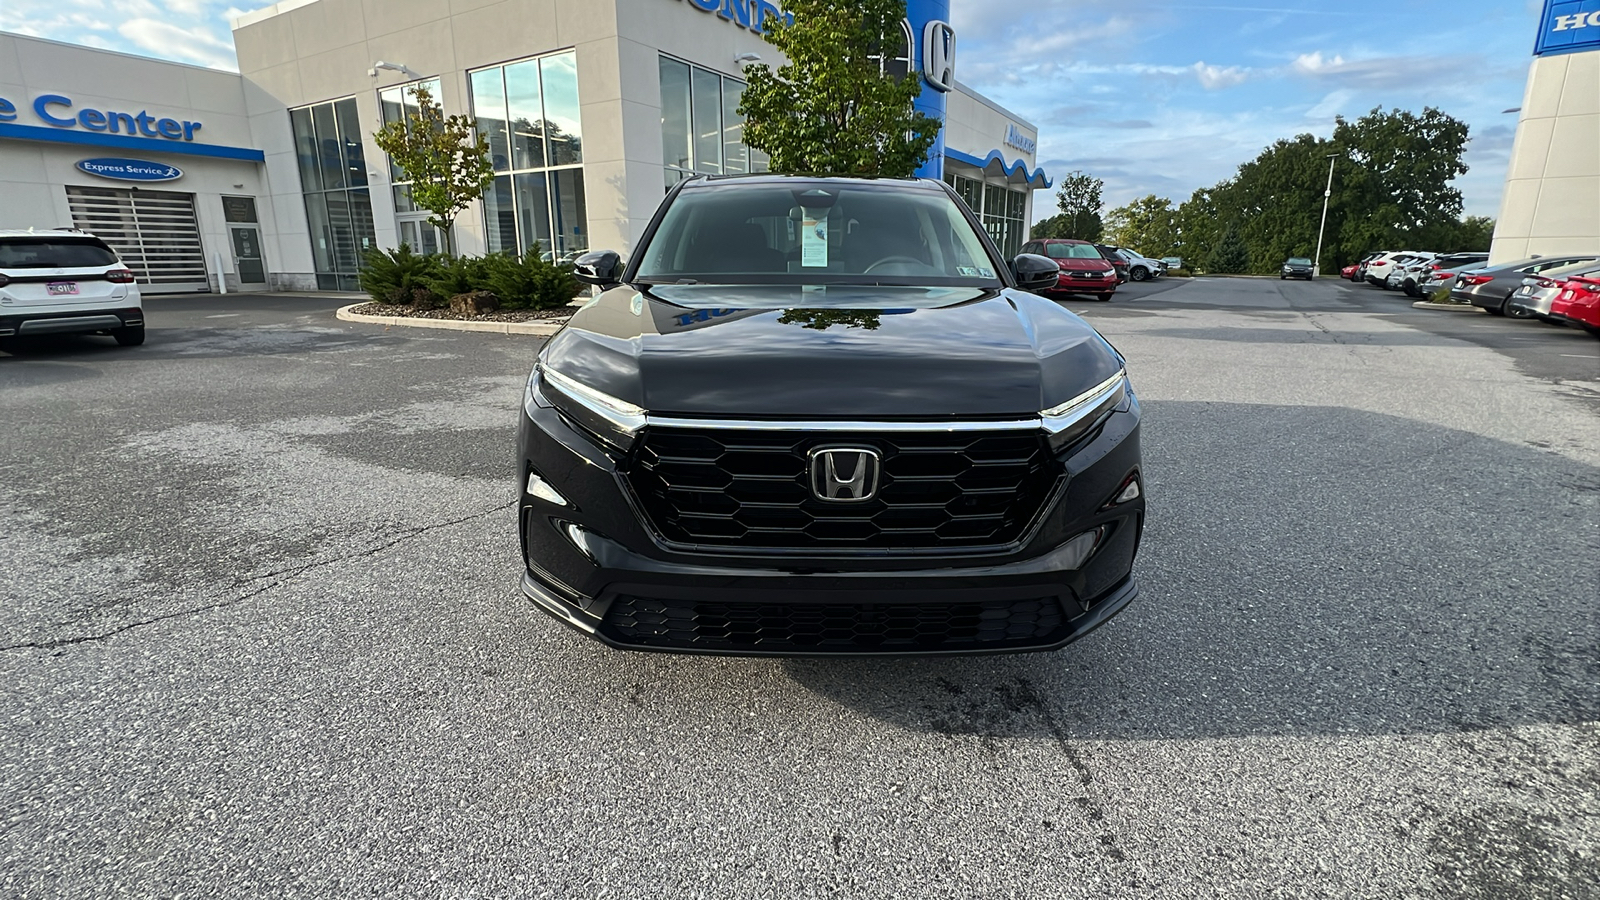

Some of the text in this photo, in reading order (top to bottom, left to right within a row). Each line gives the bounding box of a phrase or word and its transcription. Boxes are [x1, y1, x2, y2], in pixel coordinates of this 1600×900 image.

[33, 94, 202, 141] Center
[84, 162, 162, 175] Express Service
